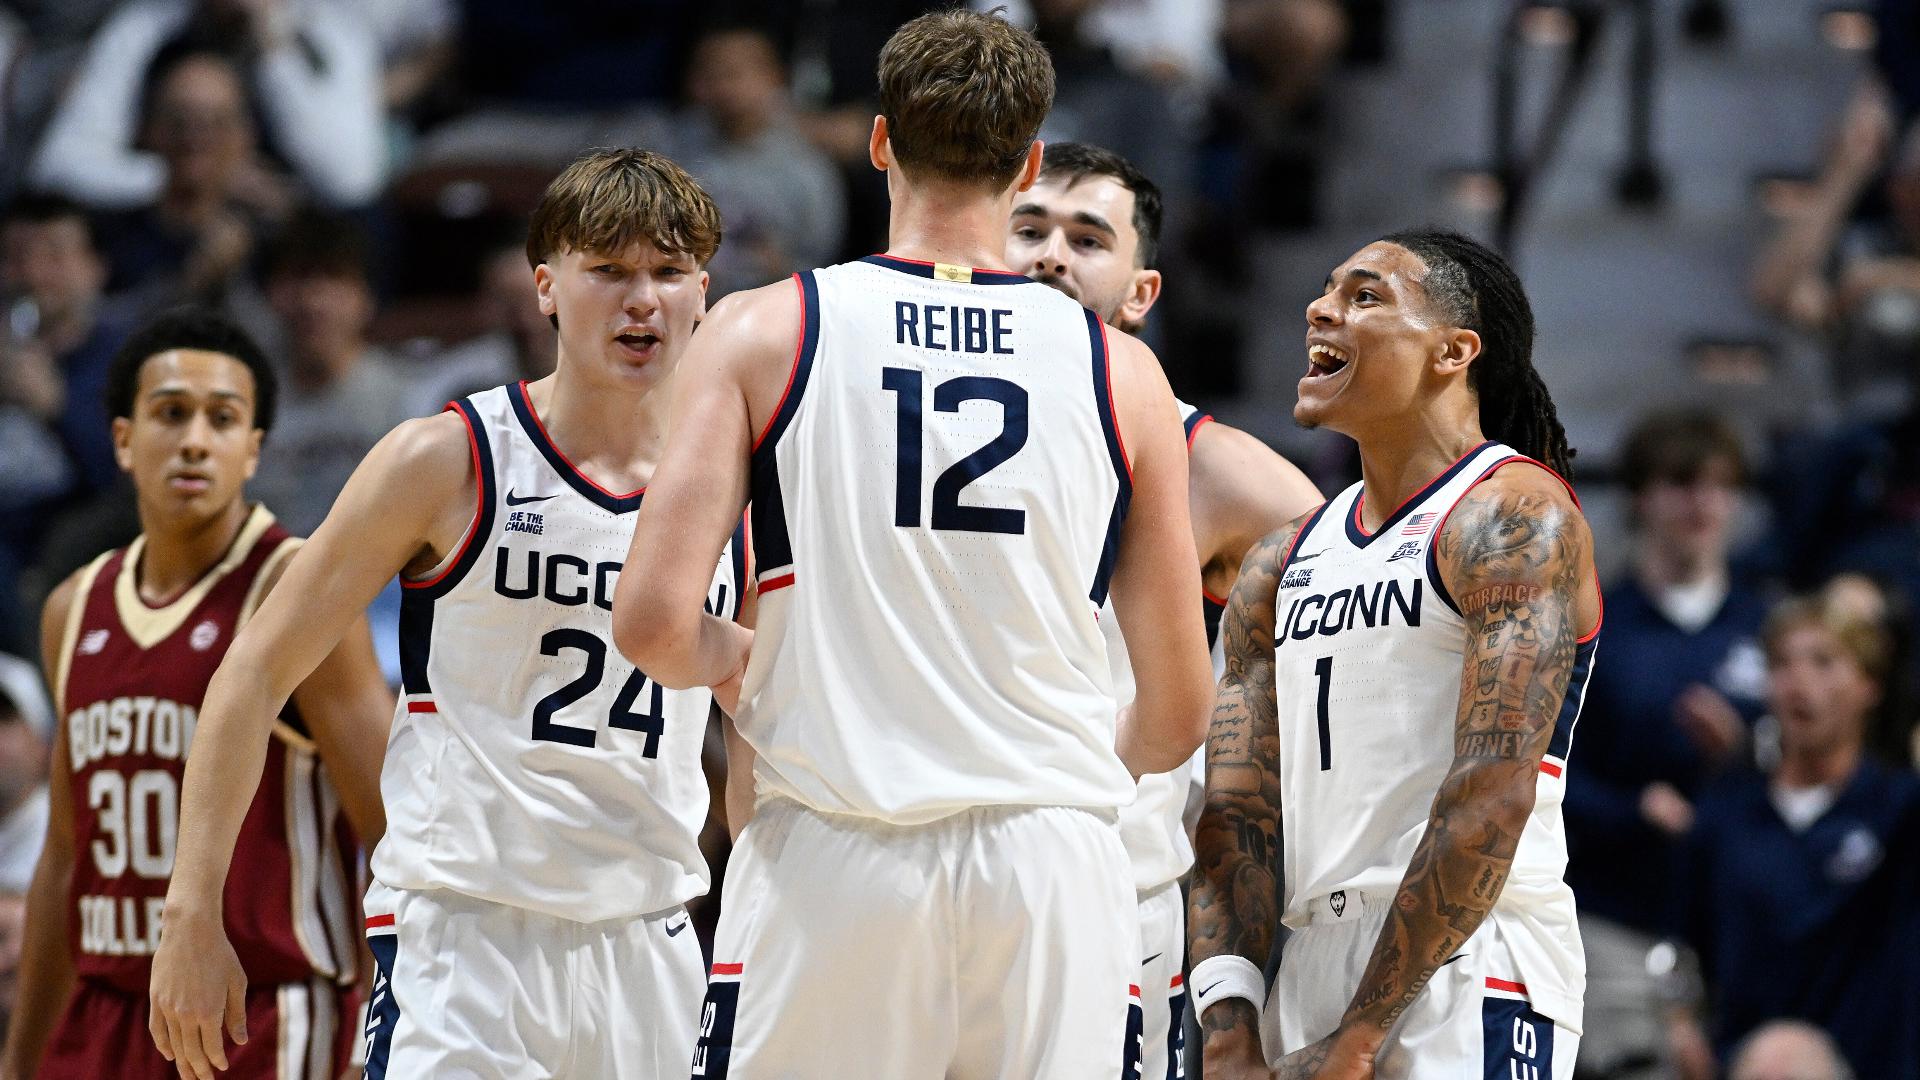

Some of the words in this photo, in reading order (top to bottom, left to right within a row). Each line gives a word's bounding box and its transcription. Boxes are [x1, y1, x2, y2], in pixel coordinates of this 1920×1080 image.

[895, 301, 1014, 354] REIBE
[882, 367, 1029, 535] 12
[505, 522, 544, 535] CHANGE
[510, 512, 524, 521] BE
[527, 513, 544, 525] THE
[1391, 549, 1421, 558] EAST
[1281, 578, 1312, 589] CHANGE
[1286, 570, 1298, 579] BE
[1298, 568, 1315, 577] THE
[1462, 584, 1539, 615] EMBRACE
[532, 628, 665, 759] 24
[1315, 656, 1333, 771] 1
[89, 769, 178, 878] 30
